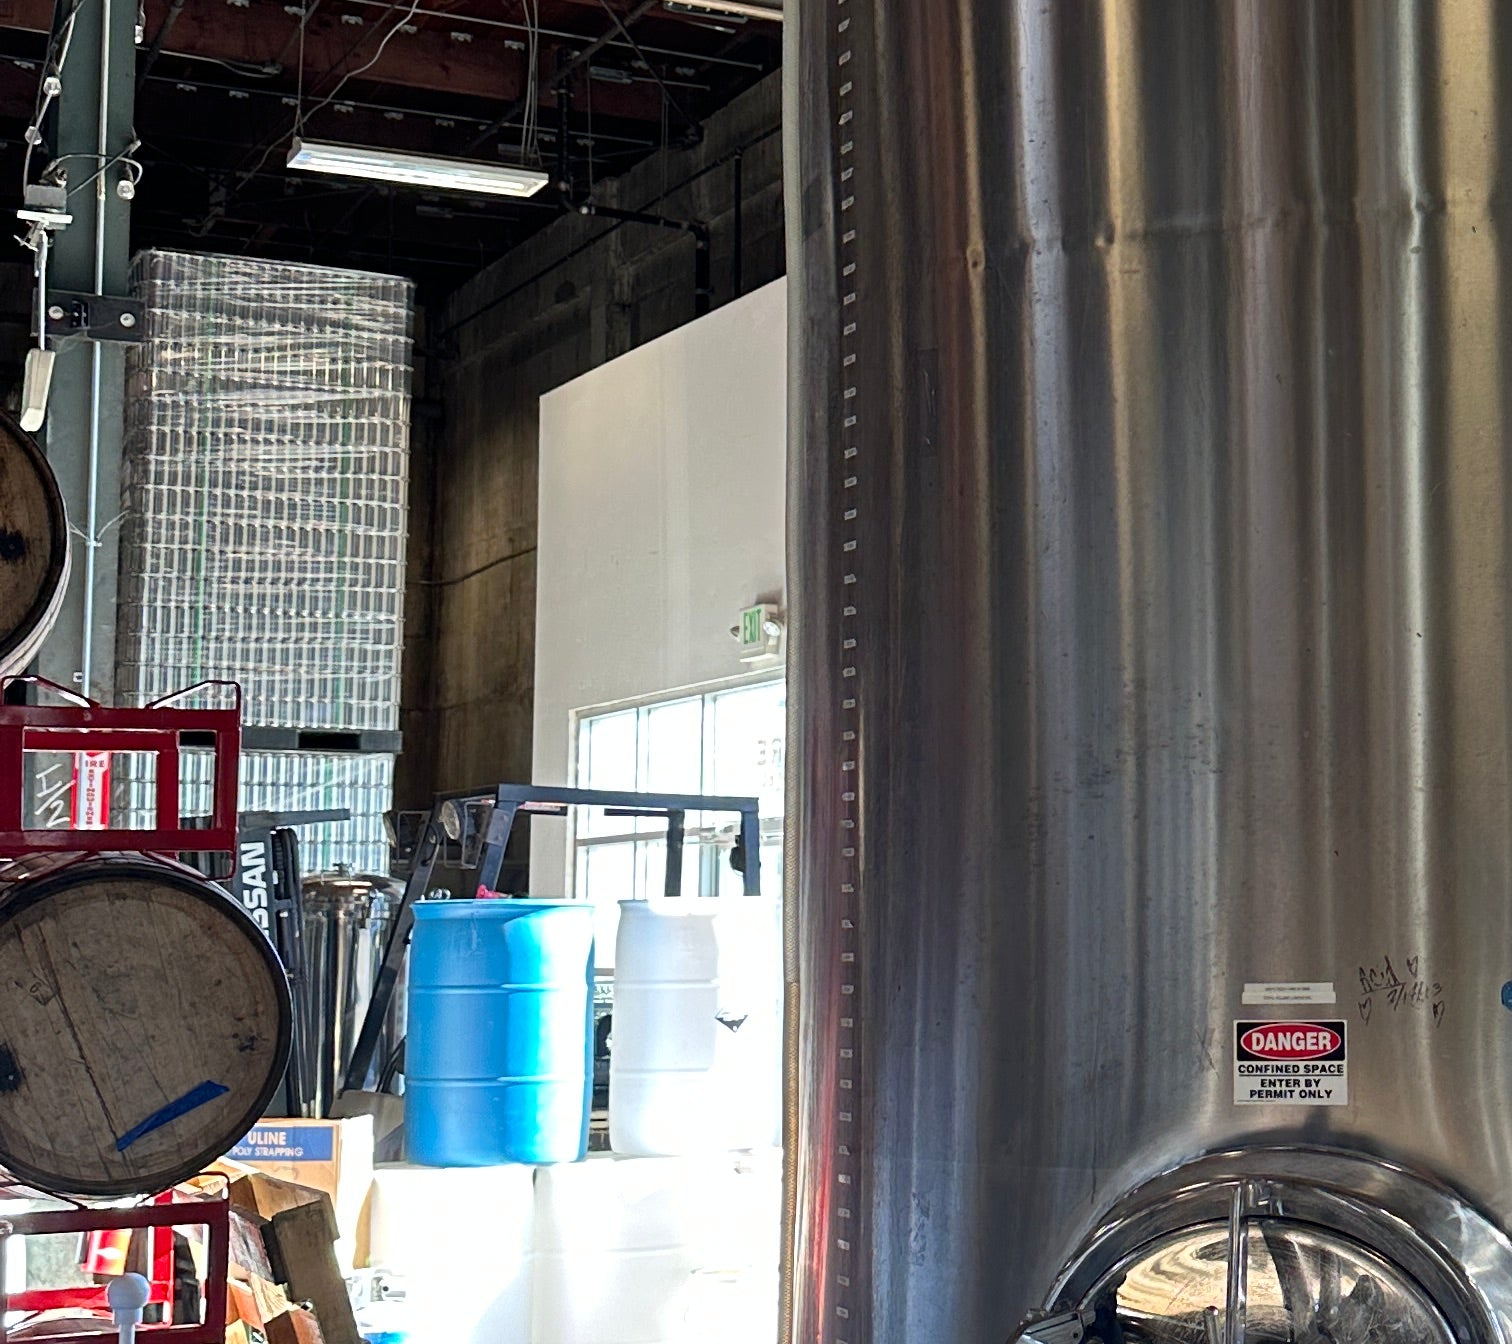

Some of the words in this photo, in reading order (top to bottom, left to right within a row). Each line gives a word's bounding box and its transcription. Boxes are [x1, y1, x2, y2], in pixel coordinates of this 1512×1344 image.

[743, 608, 761, 644] EXIT
[85, 760, 105, 768] IRE
[240, 841, 270, 937] SSAN
[1251, 1032, 1332, 1051] DANGER
[1238, 1064, 1300, 1074] CONFINED
[1303, 1064, 1344, 1074] SPACE
[1260, 1079, 1301, 1088] ENTER
[1305, 1079, 1321, 1088] BY
[1250, 1089, 1295, 1099] PERMIT
[1299, 1089, 1333, 1099] ONLY
[247, 1131, 287, 1145] ULINE
[233, 1146, 252, 1156] POLY
[254, 1146, 304, 1157] STRAPPING
